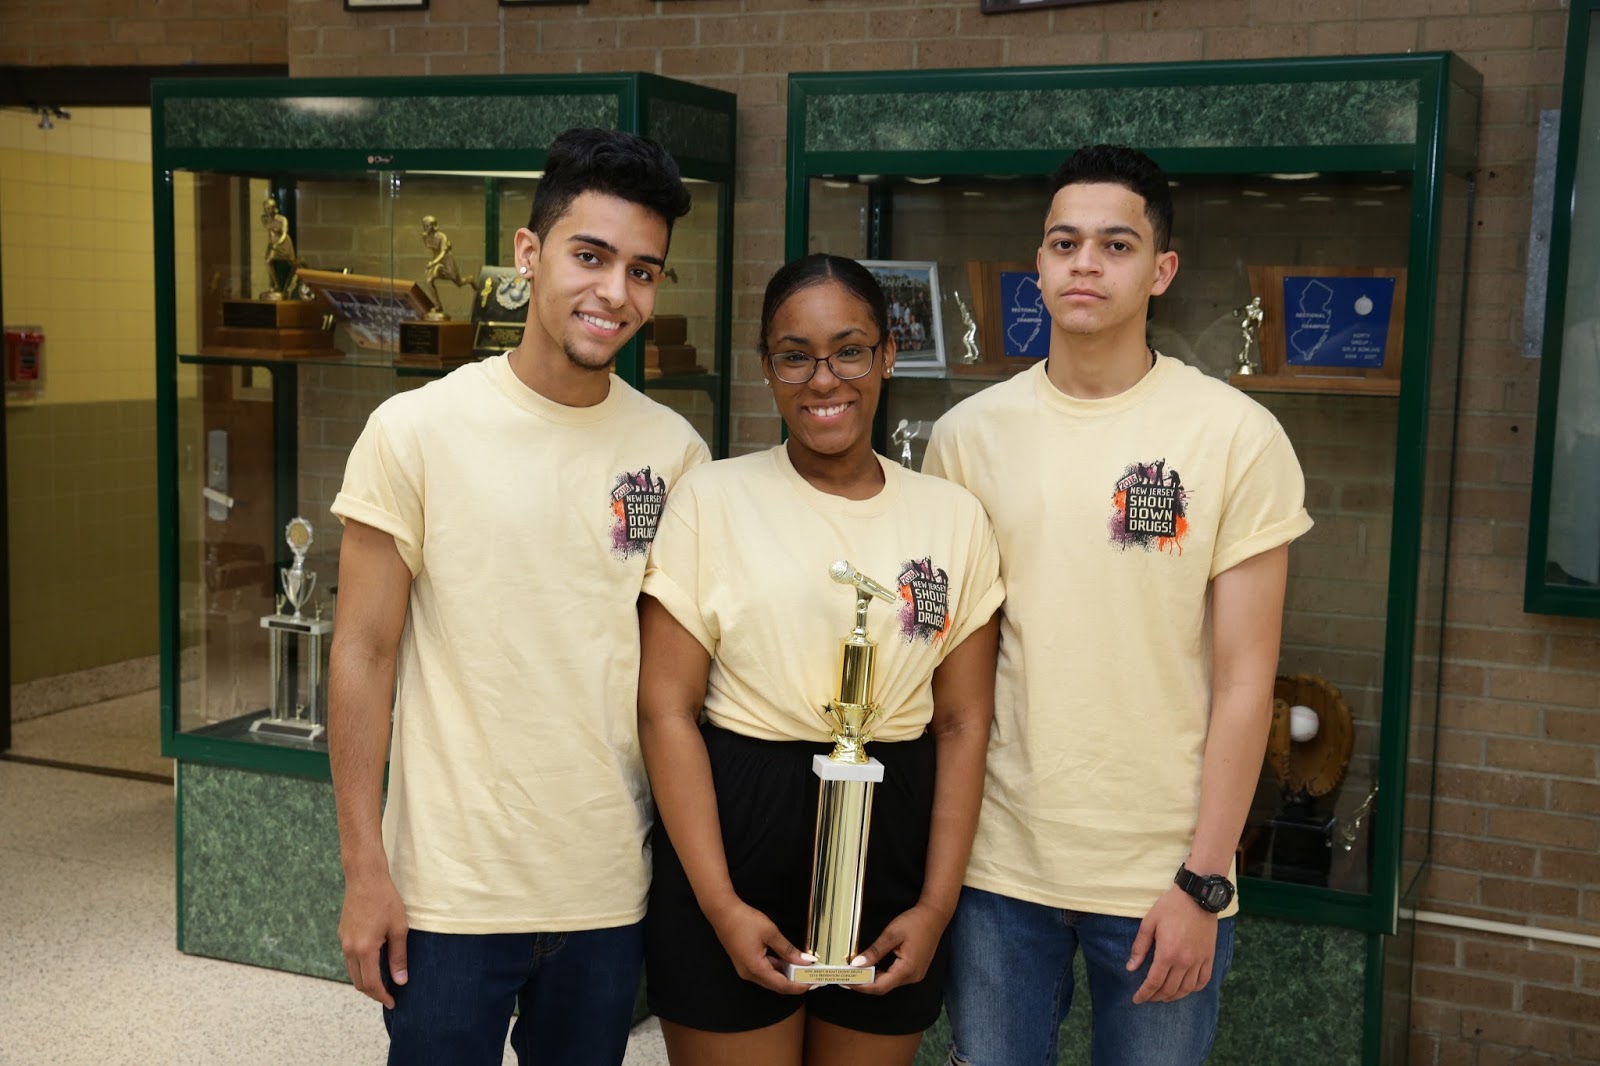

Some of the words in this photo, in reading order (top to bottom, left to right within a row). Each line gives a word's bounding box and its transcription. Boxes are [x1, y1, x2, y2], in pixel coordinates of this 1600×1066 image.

[1120, 475, 1138, 490] 2016
[614, 484, 631, 500] 2016
[626, 494, 642, 502] NEW
[644, 495, 662, 503] JERSEY
[1149, 488, 1174, 496] JERSEY
[1130, 496, 1174, 508] SHOUT
[628, 504, 660, 514] SHOUT
[1130, 507, 1172, 520] DOWN
[1130, 520, 1172, 534] DRUGS!
[902, 570, 916, 586] 2016
[912, 580, 928, 588] NEW
[928, 582, 946, 592] JERSEY
[914, 588, 946, 604] SHOUT
[917, 600, 946, 616] DOWN
